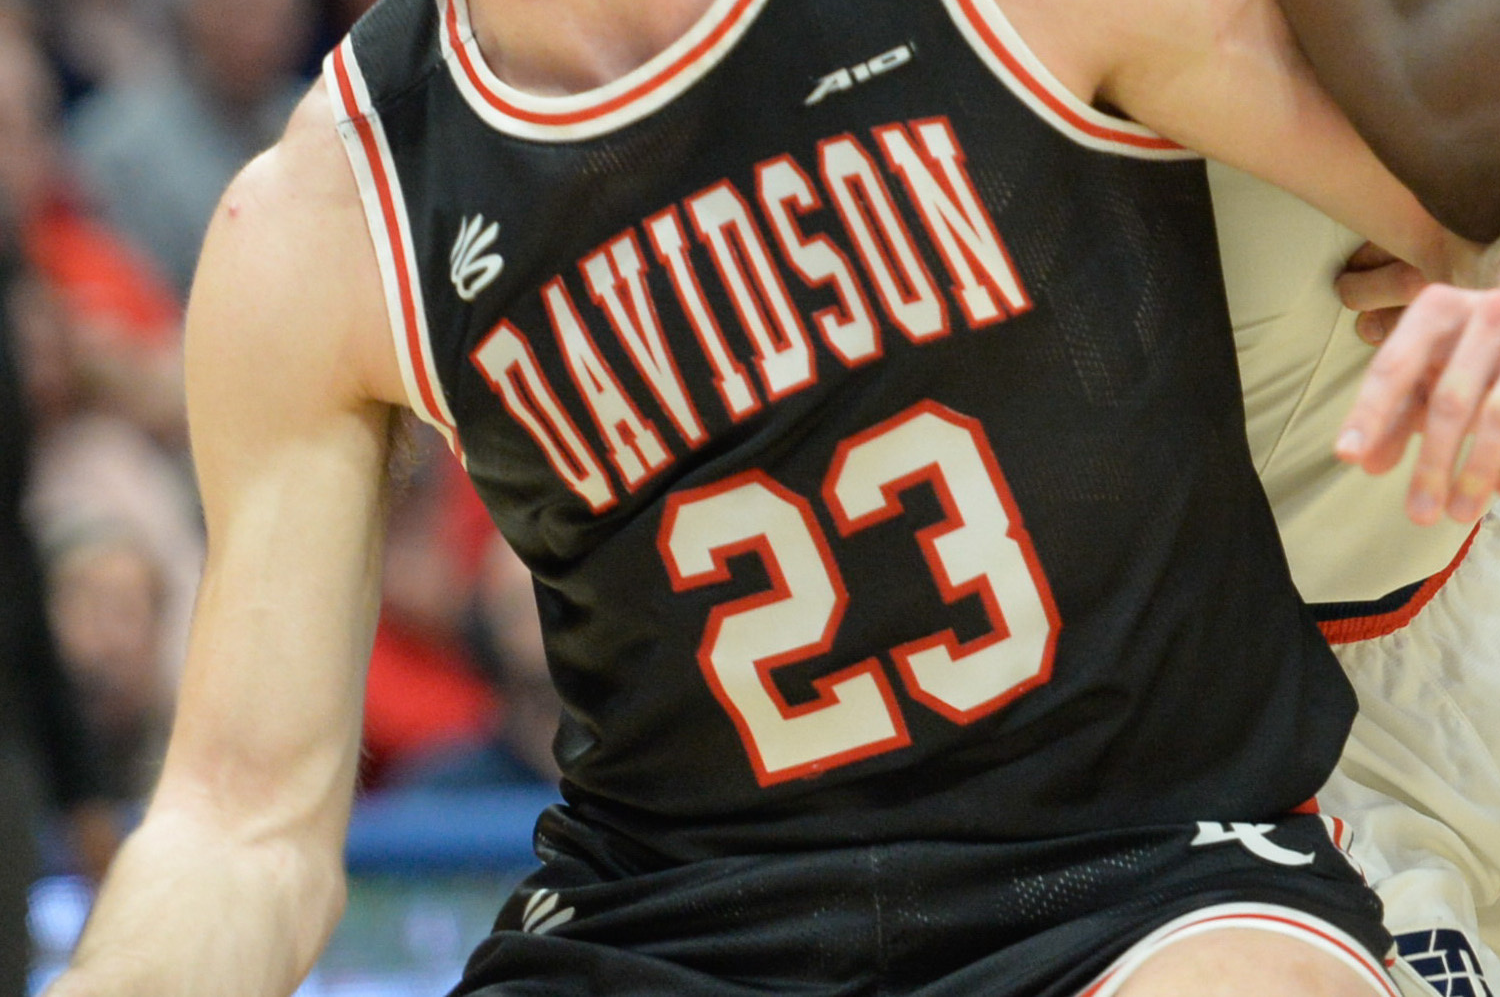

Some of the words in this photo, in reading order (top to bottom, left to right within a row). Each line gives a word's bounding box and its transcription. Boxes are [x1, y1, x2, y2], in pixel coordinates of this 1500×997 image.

[803, 40, 917, 106] A10
[469, 116, 1034, 515] DAVIDSON
[657, 399, 1061, 788] 23
